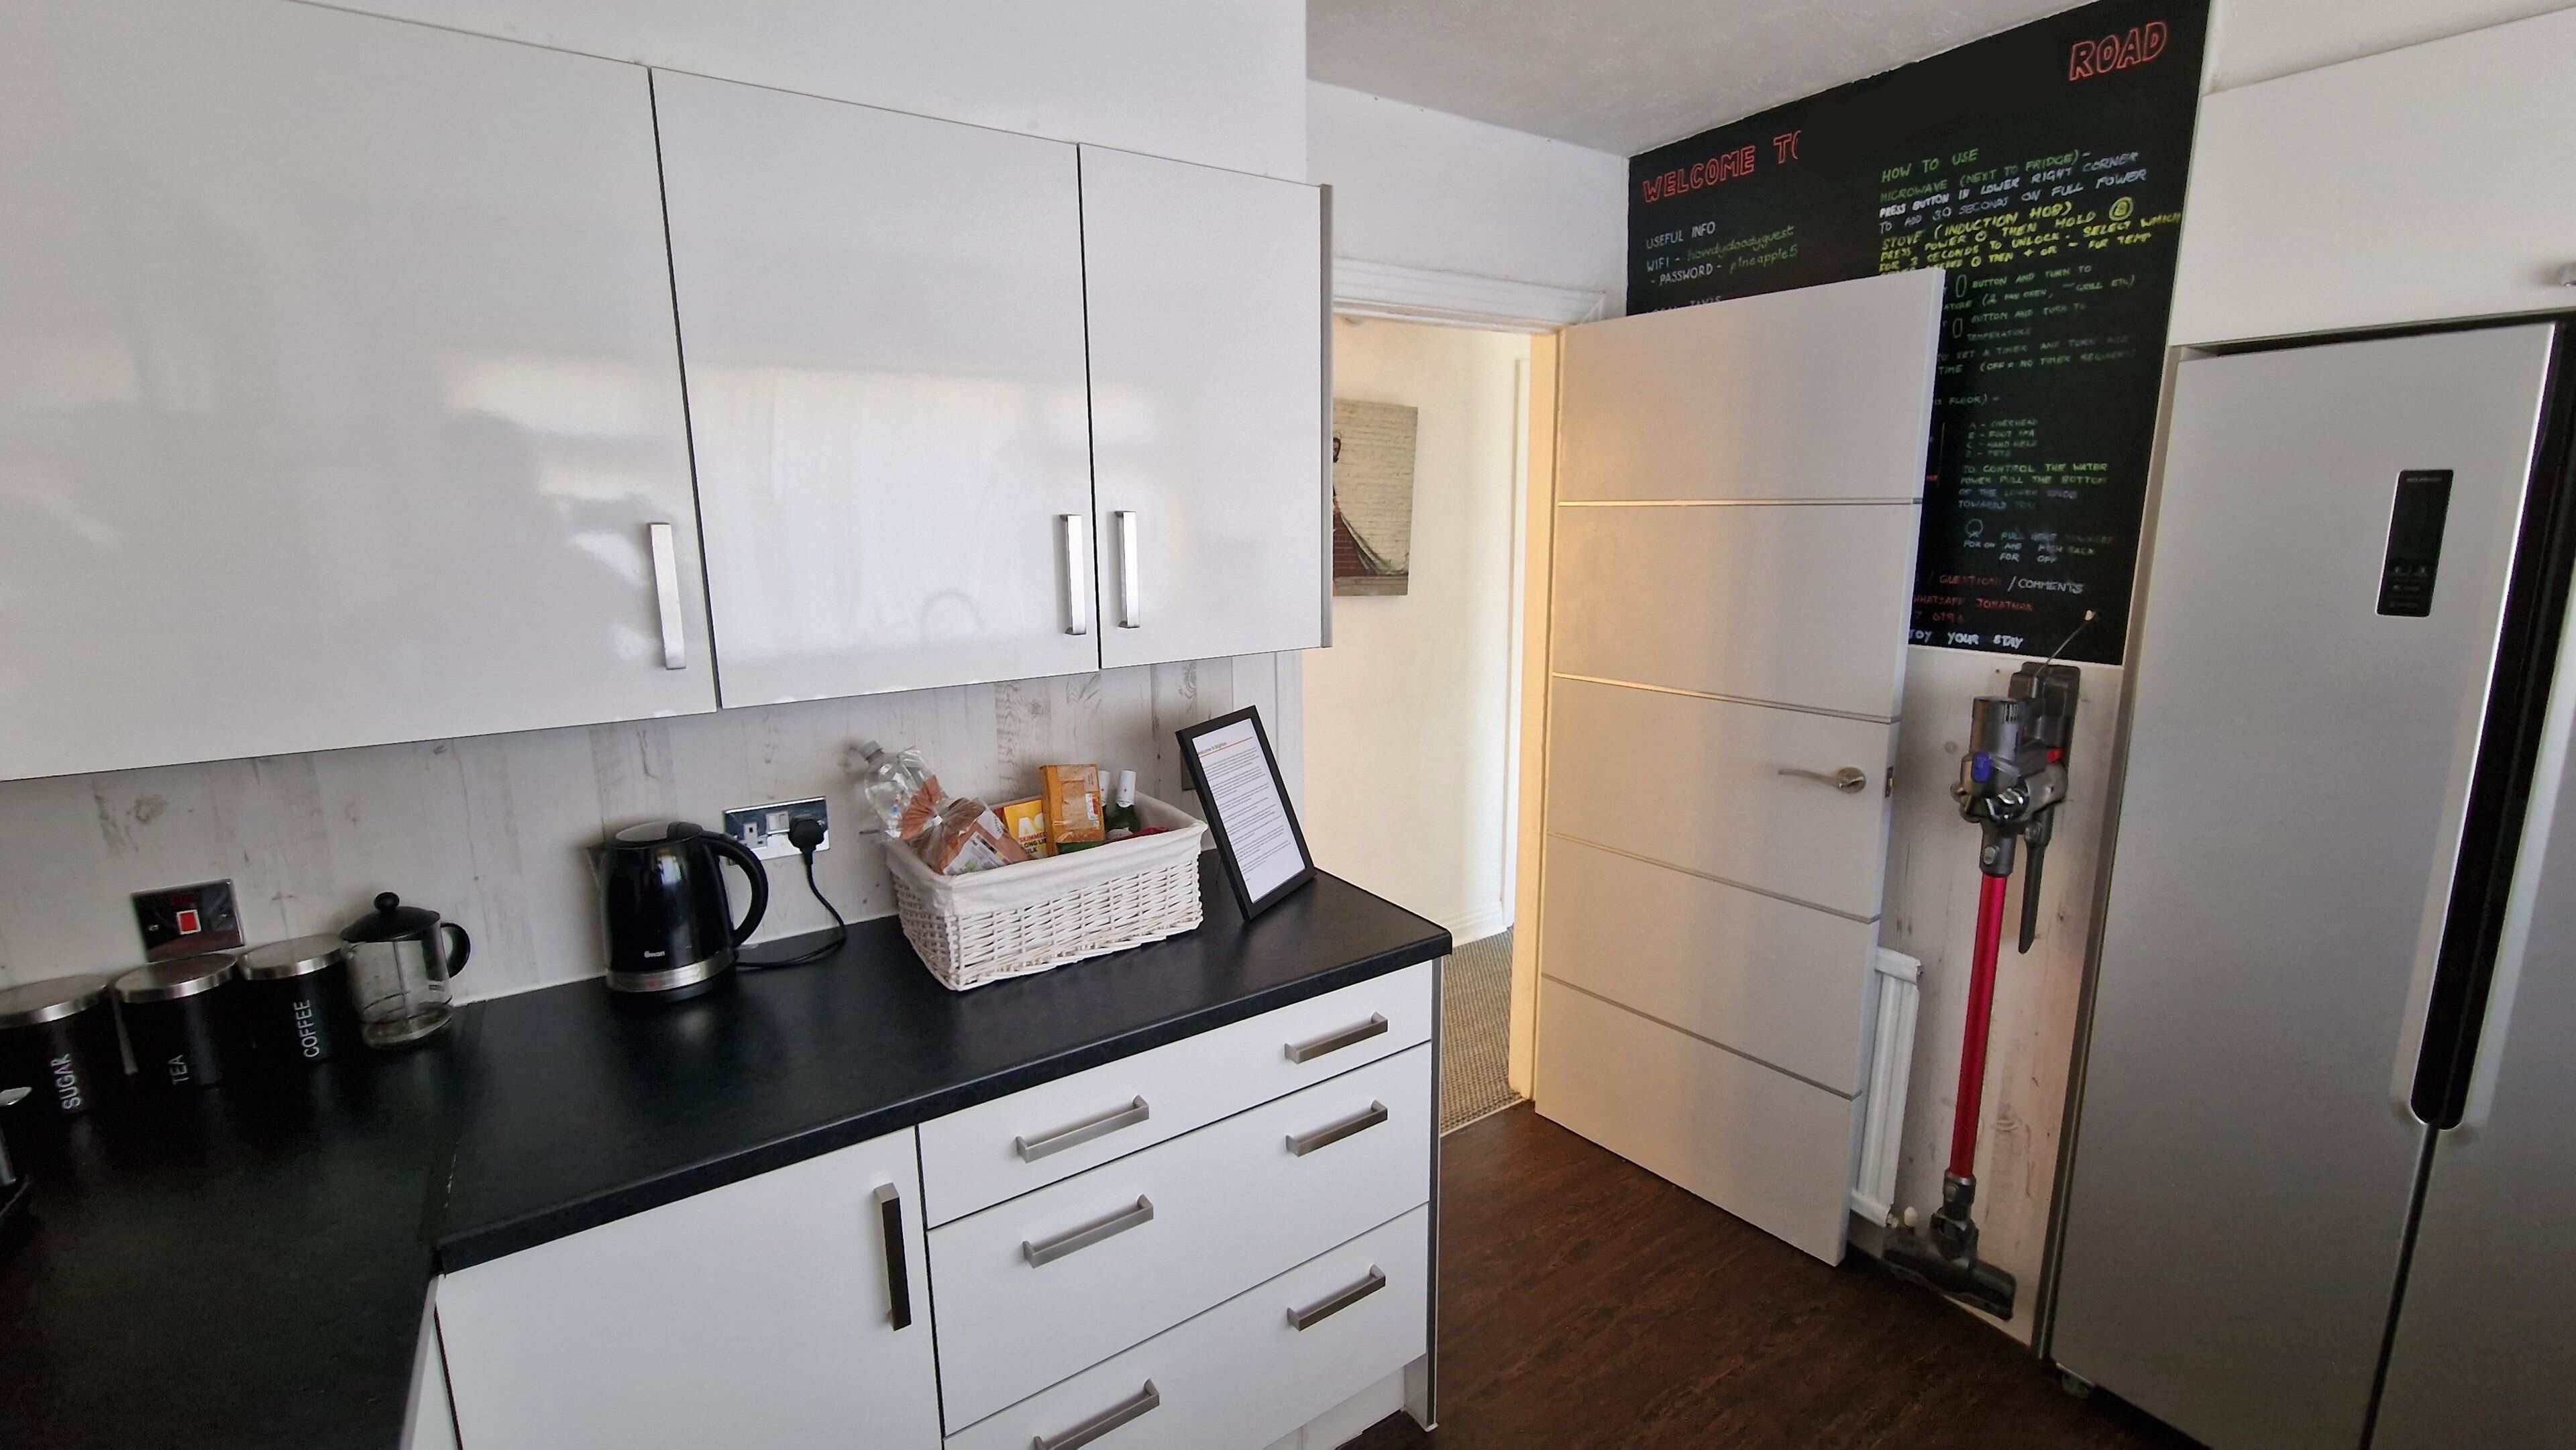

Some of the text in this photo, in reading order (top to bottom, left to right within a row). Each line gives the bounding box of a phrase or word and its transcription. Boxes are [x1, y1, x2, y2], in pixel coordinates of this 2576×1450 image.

[2069, 21, 2167, 81] ROAD
[1643, 144, 1757, 203] WELCOME
[1881, 148, 1979, 183] HOW TO USE
[1879, 150, 2139, 219] PRESS BUTTON IN LOWER RIGHT CORNER
[1880, 179, 1948, 203] MICROWAVE
[2004, 164, 2019, 176] TO
[1879, 168, 2147, 234] TO ADD 30 SECONDS ON FULL POWER
[1646, 221, 1716, 249] USEFUL INFO
[2002, 222, 2037, 238] THEN
[2054, 211, 2096, 229] HOLD
[2082, 220, 2131, 237] SELECT
[1882, 229, 1925, 251] STOVE
[1646, 256, 1669, 272] WIFI
[1659, 262, 1713, 287] PASSWORD
[1972, 264, 2092, 289] BUTTON AND TURN TO
[1982, 464, 2035, 473] CONTROL
[2072, 462, 2108, 472] WATER
[2000, 552, 2020, 563] FOR
[1947, 631, 1980, 645] YOUR
[1993, 634, 2023, 650] STAY
[293, 999, 320, 1058] COFFEE
[50, 1053, 81, 1110] SUGAR
[167, 1054, 190, 1086] TEA
